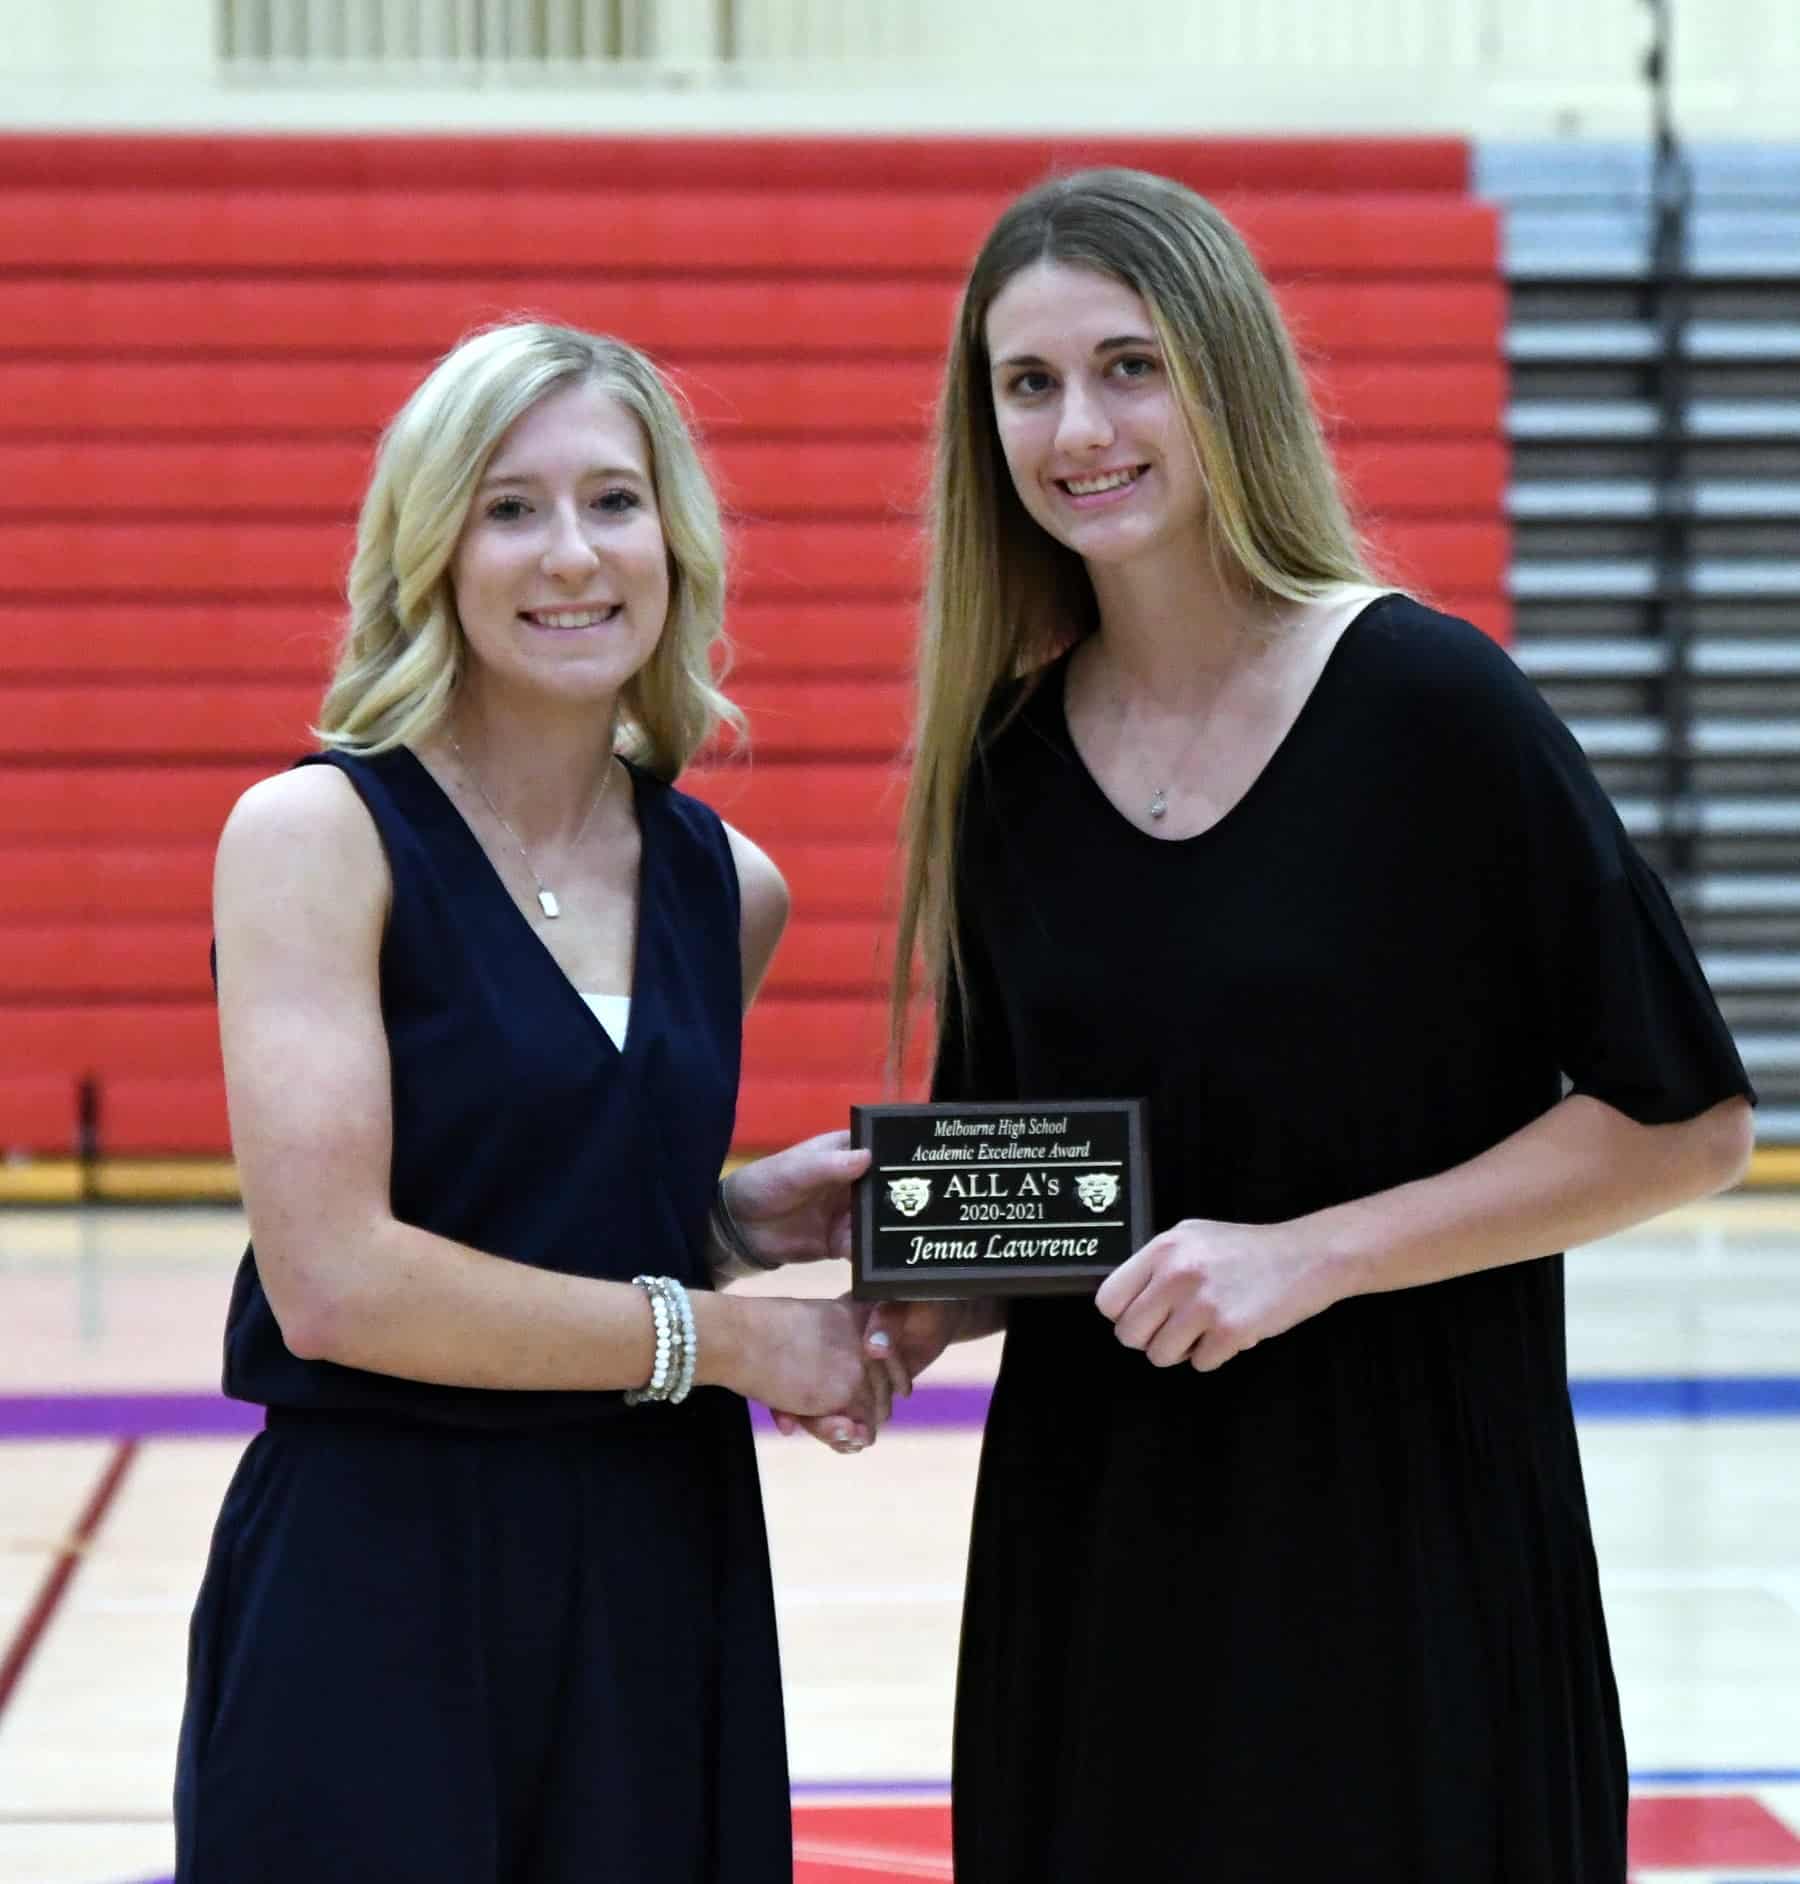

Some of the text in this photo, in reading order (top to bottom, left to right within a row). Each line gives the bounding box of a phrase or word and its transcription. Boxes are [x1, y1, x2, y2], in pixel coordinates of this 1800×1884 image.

[934, 1116, 1067, 1139] Melbourne High School
[911, 1141, 1090, 1162] Academic Excellence Award
[943, 1171, 1060, 1199] ALL A's
[959, 1203, 1045, 1222] 2020-2021
[906, 1234, 1098, 1264] Jenna Lawrence
